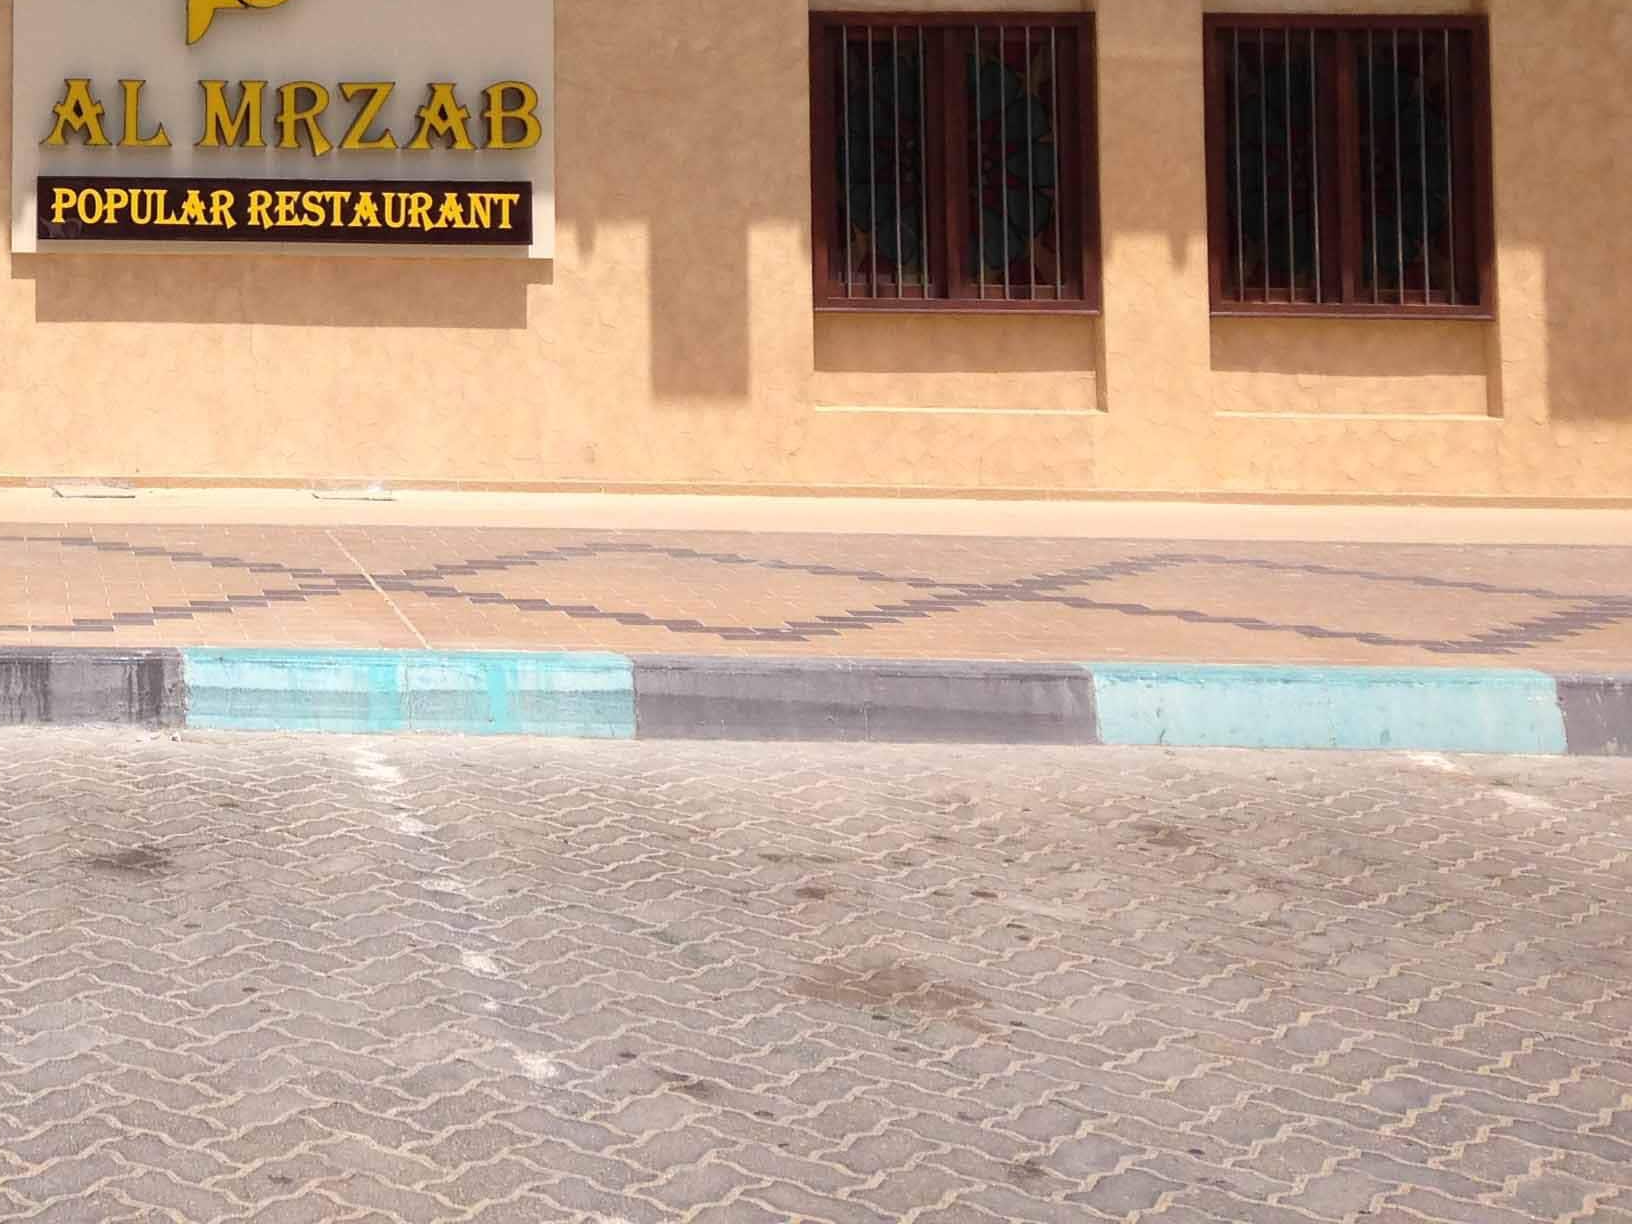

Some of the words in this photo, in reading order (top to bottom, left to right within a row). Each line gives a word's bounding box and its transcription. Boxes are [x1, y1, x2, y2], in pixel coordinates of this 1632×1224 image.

[40, 78, 171, 148] AL
[194, 80, 542, 157] MRZAB
[51, 187, 237, 228] POPULAR
[247, 191, 519, 231] RESTAURANT
